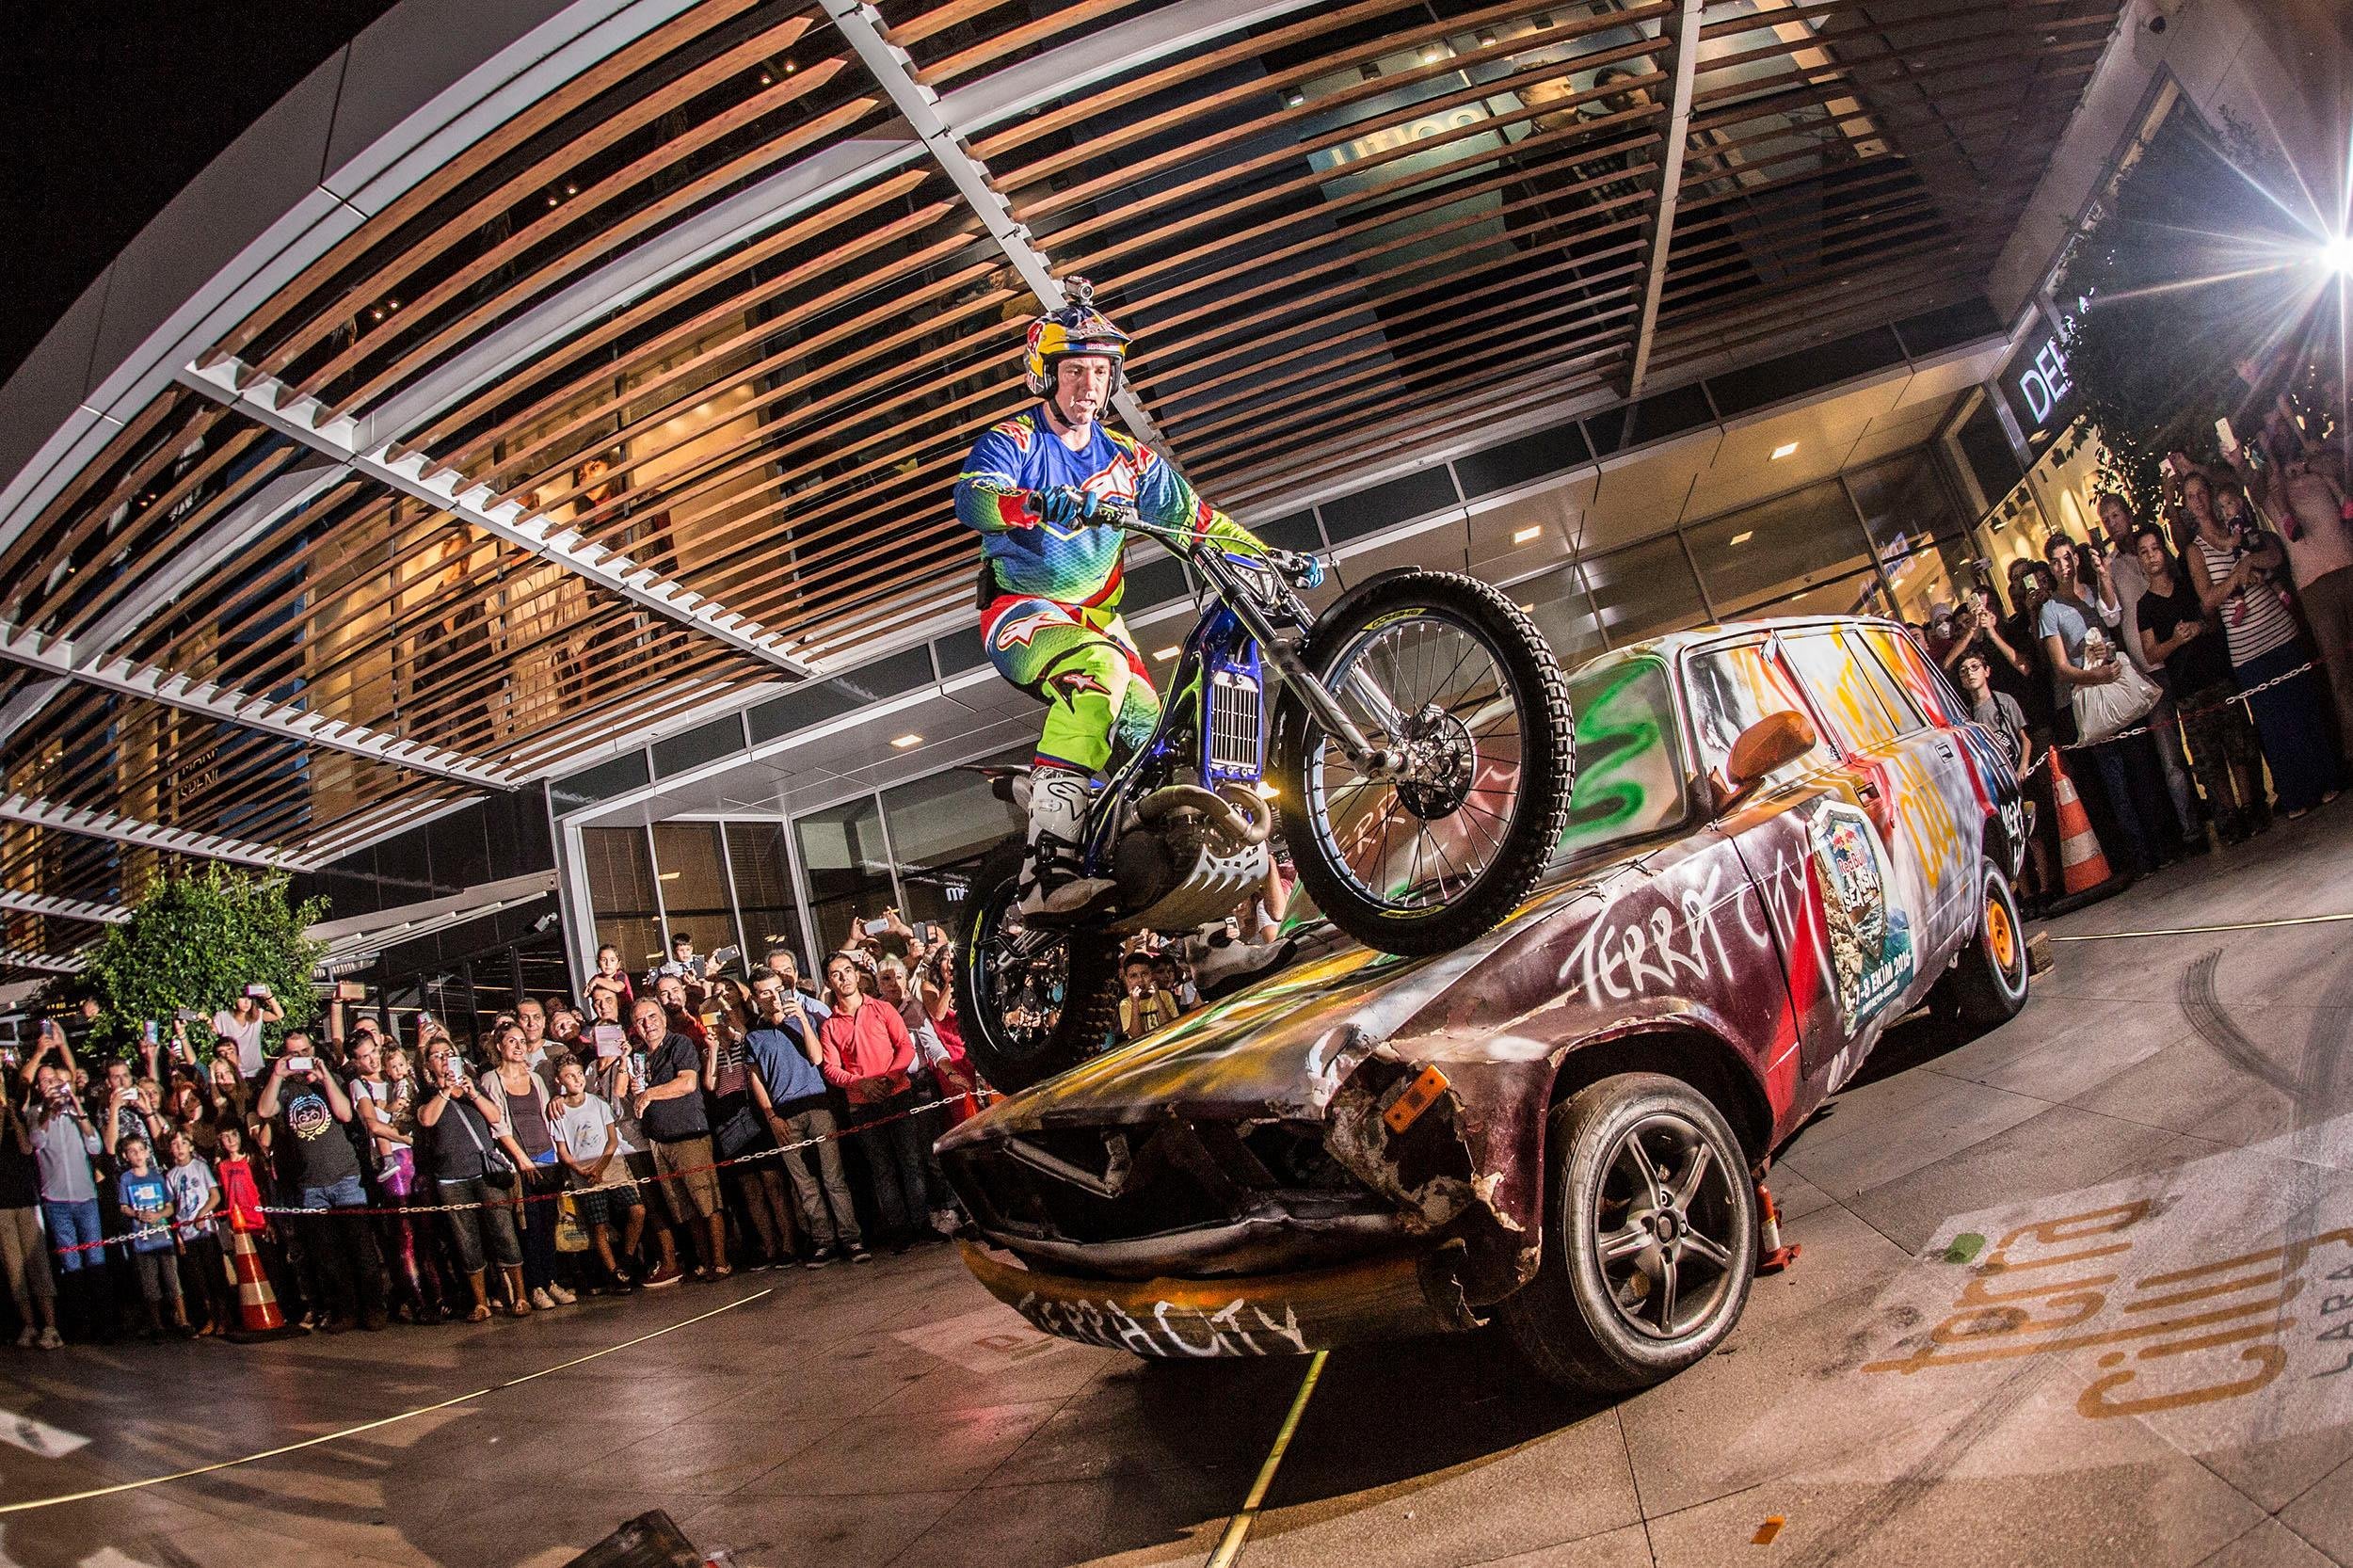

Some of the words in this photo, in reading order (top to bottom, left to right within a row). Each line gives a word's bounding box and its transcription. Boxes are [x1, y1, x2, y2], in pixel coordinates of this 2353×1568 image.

[1837, 857, 1853, 876] Red
[1851, 851, 1867, 872] Bull
[1559, 864, 1734, 1007] TERRA
[1871, 959, 1895, 991] EKİM
[1154, 1298, 1310, 1358] CITY
